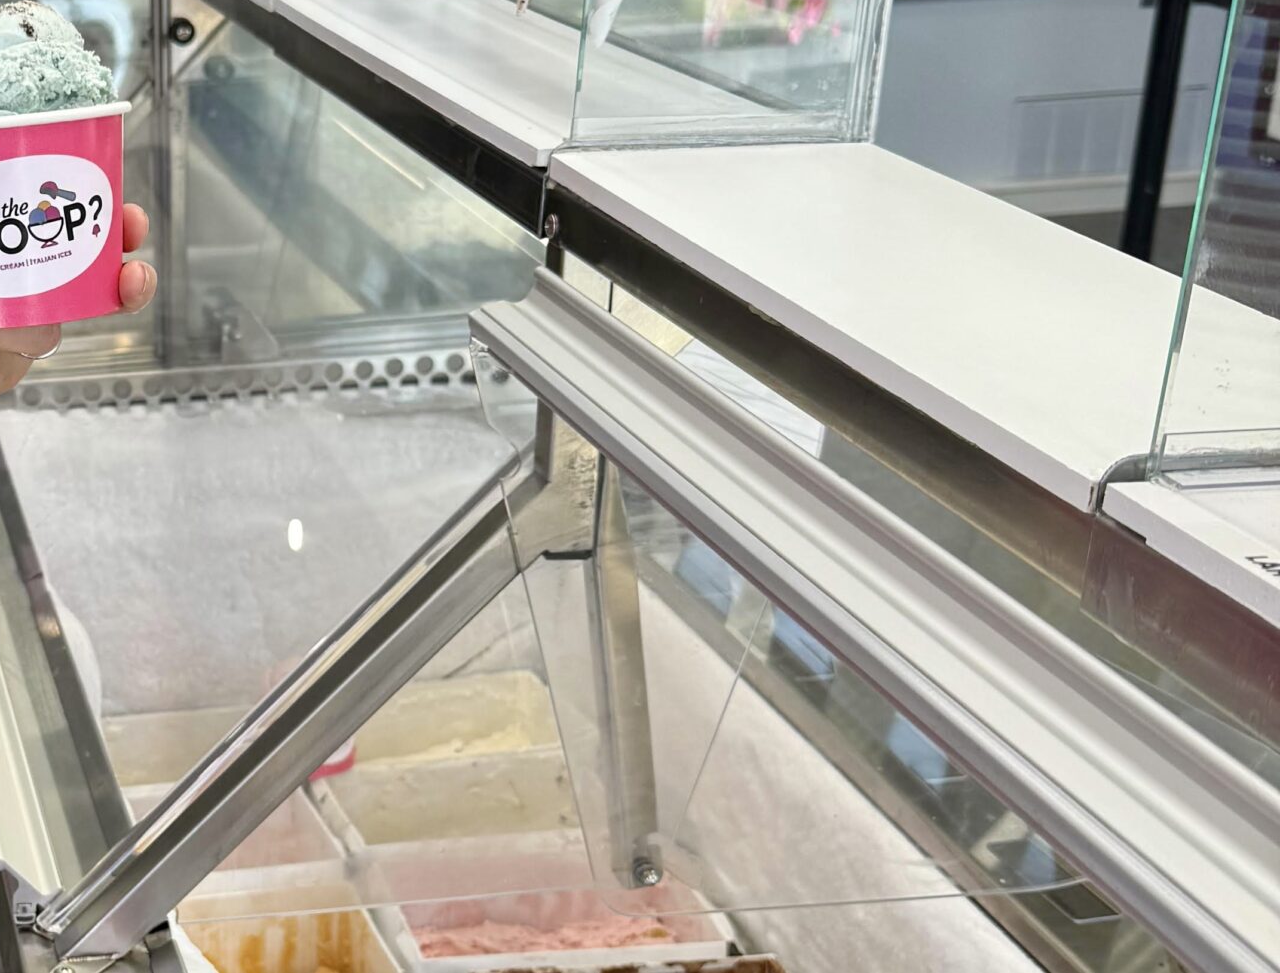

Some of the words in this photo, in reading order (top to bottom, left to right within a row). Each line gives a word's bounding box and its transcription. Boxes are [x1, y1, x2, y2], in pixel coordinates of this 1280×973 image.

[1, 197, 29, 218] the
[0, 261, 25, 270] CREAM
[29, 254, 57, 266] ITALIAN
[57, 250, 72, 261] ICES
